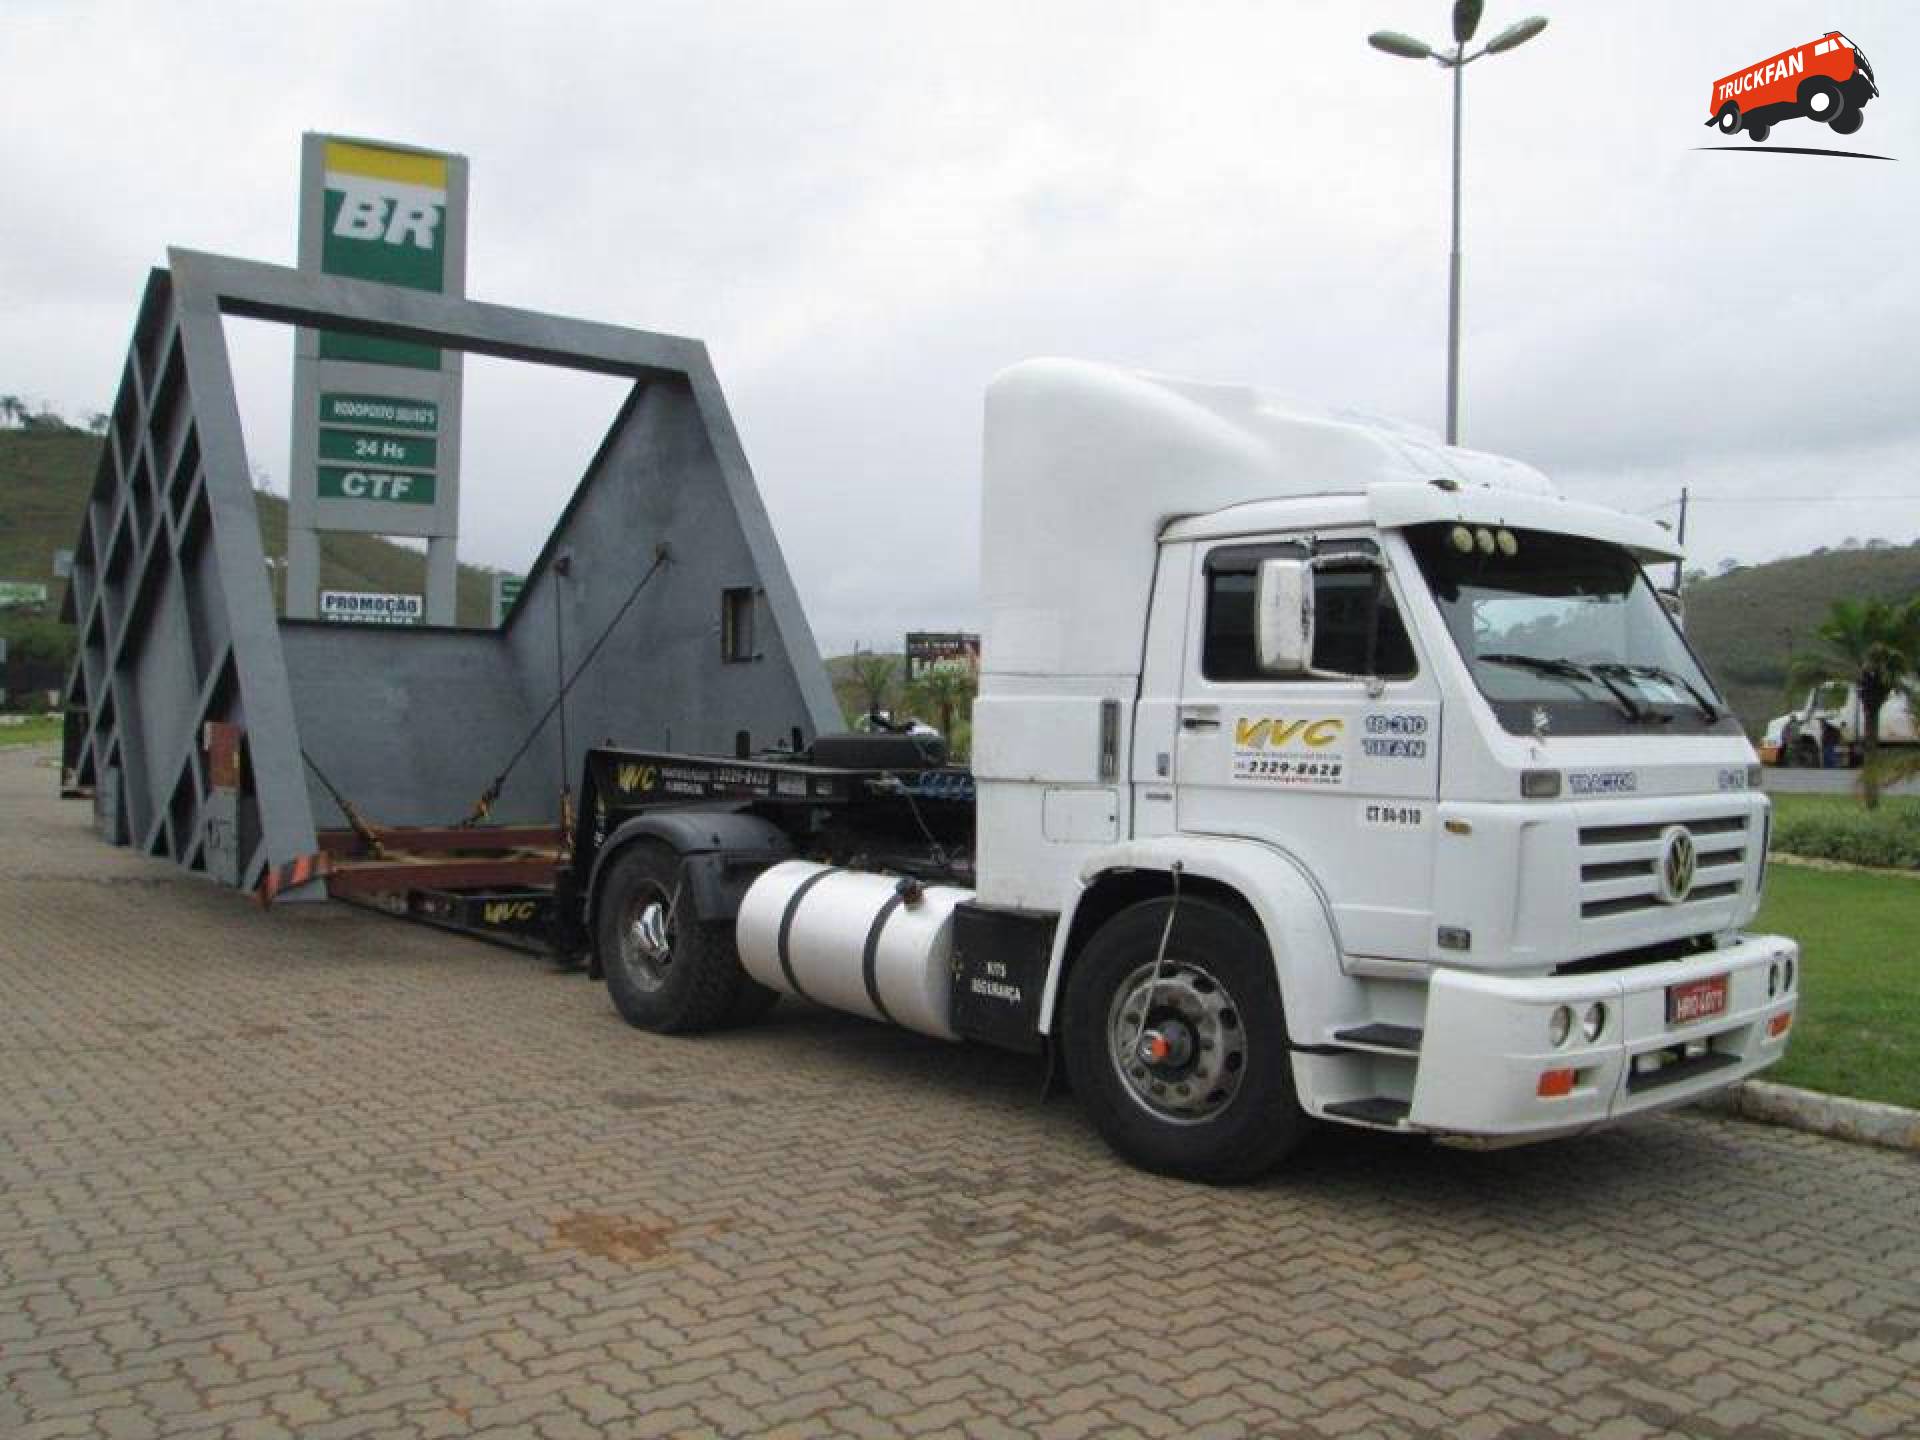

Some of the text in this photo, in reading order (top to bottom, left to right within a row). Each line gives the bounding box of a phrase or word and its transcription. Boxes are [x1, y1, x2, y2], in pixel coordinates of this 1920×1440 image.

[332, 192, 441, 250] BR
[355, 439, 405, 459] 24 Hs
[341, 471, 413, 498] CTF
[325, 595, 418, 613] PROMOÇÃO
[1362, 739, 1426, 758] TITAN
[1366, 806, 1379, 822] CT
